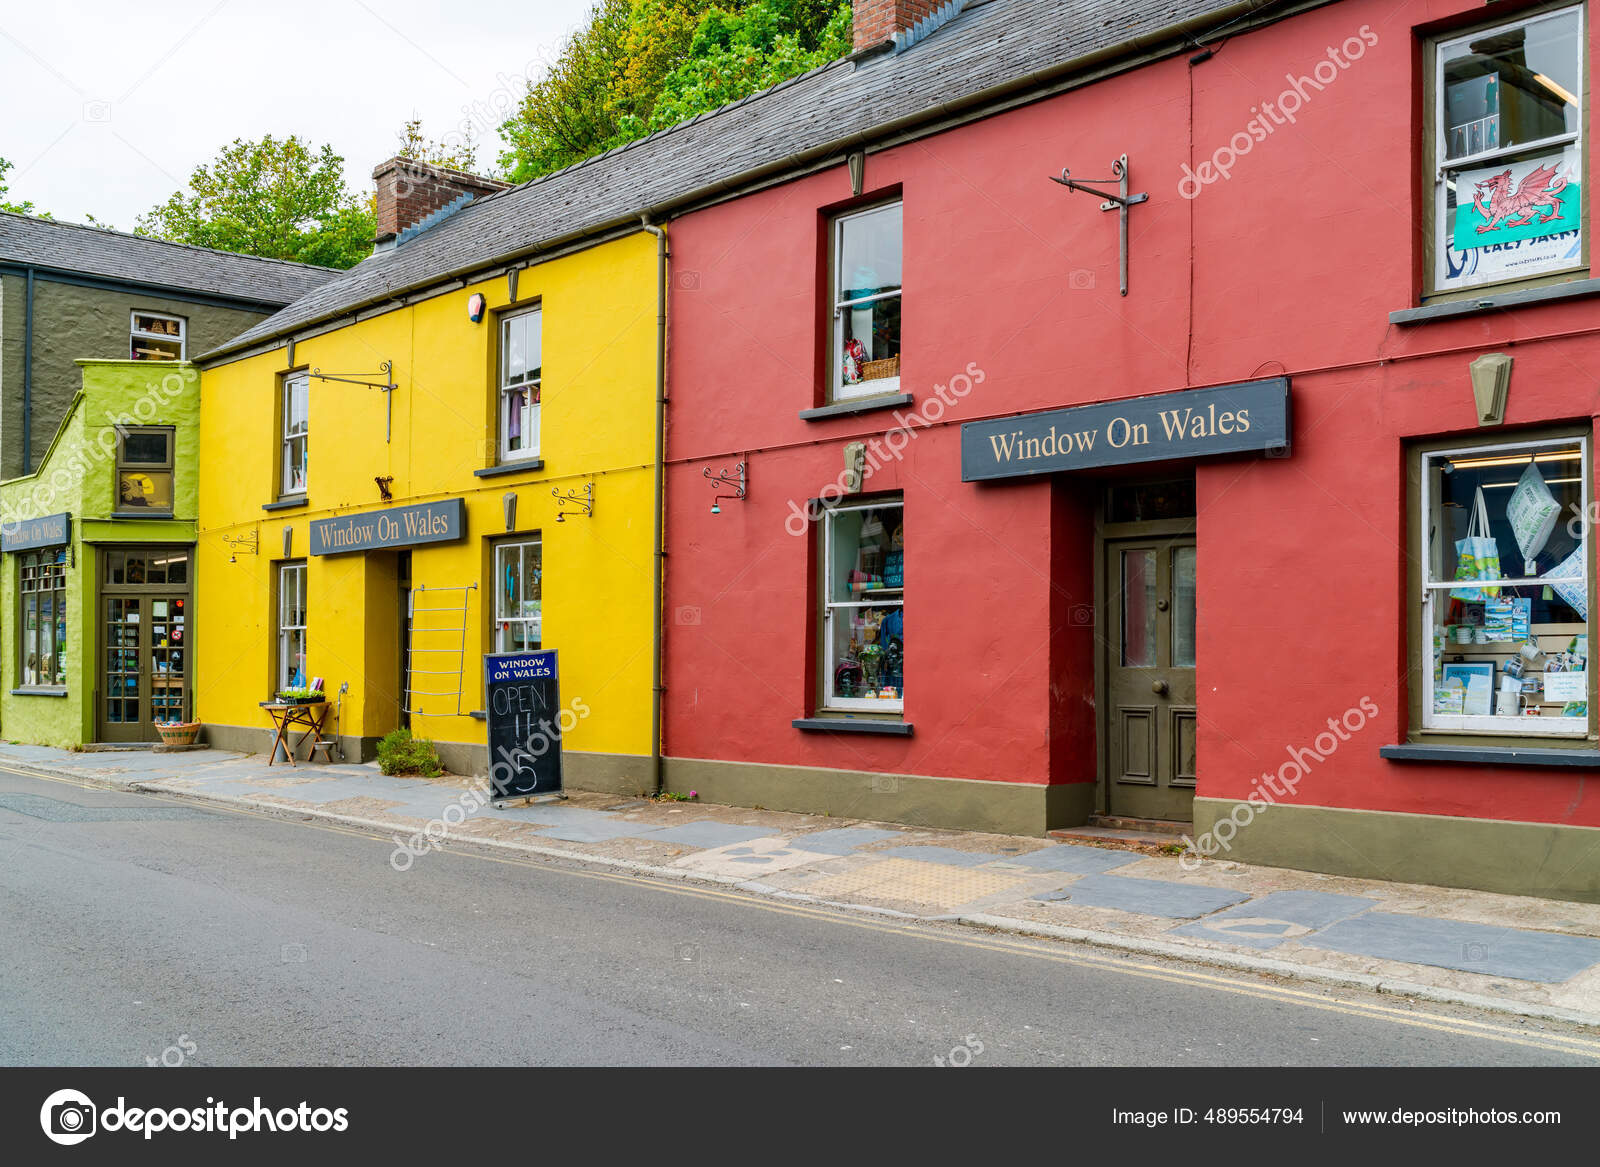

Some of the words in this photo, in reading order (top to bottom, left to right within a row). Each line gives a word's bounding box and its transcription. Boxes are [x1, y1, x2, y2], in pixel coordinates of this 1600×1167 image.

[989, 427, 1098, 464] Window
[1107, 417, 1149, 449] On
[1158, 404, 1251, 442] Wales
[320, 520, 374, 548] Window
[378, 515, 399, 541] On
[403, 508, 448, 537] Wales
[494, 670, 510, 680] ON
[513, 667, 551, 679] WALES
[498, 658, 546, 670] WINDOW
[492, 682, 548, 716] OPEN
[516, 754, 537, 792] 5
